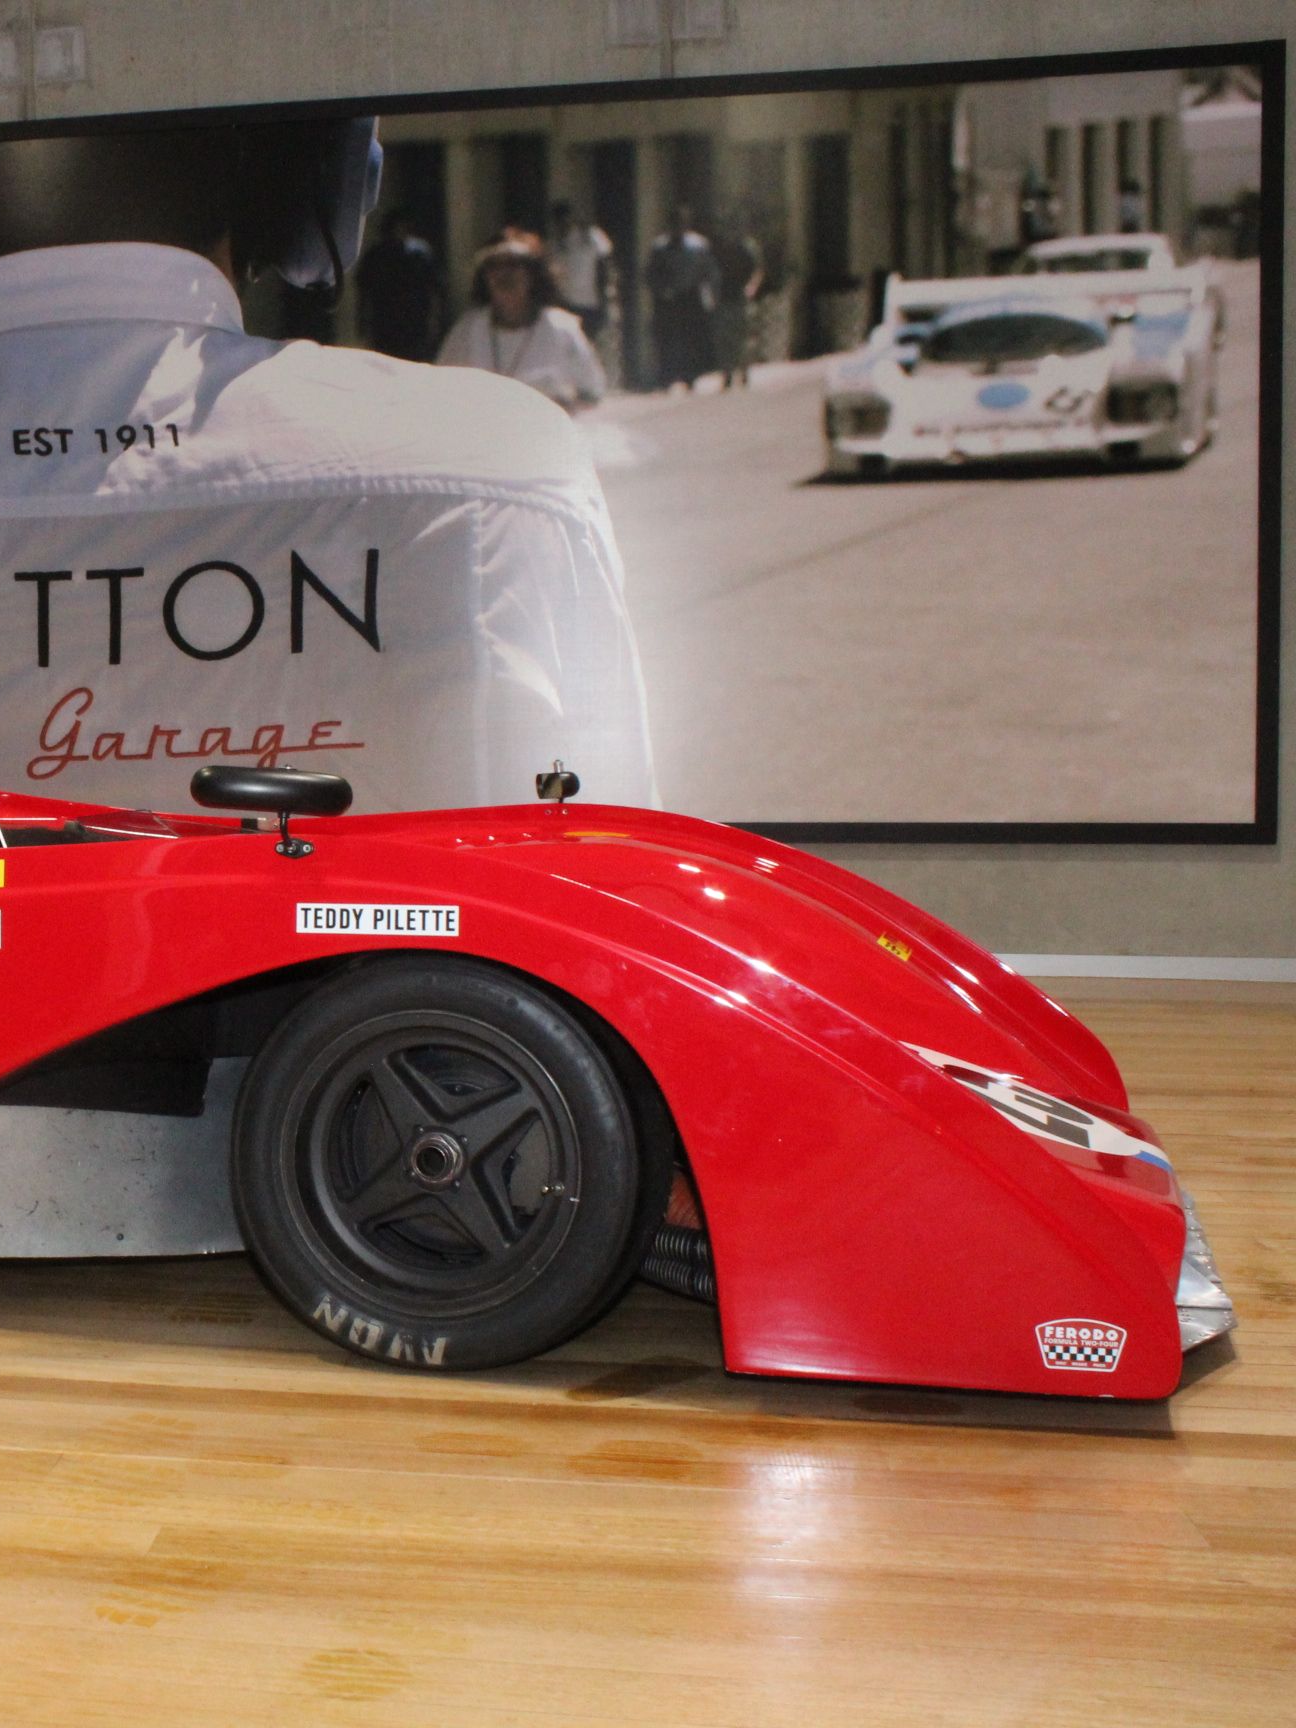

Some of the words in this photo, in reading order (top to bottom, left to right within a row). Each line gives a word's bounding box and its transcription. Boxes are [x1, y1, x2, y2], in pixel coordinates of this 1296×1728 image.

[12, 427, 73, 456] EST
[94, 423, 179, 453] 1911
[26, 686, 365, 780] Garage
[301, 907, 364, 930] TEDDY
[373, 908, 456, 931] PILETTE
[312, 1295, 449, 1366] AVON
[1044, 1337, 1078, 1346] FORMULA
[1045, 1326, 1119, 1341] FERODO
